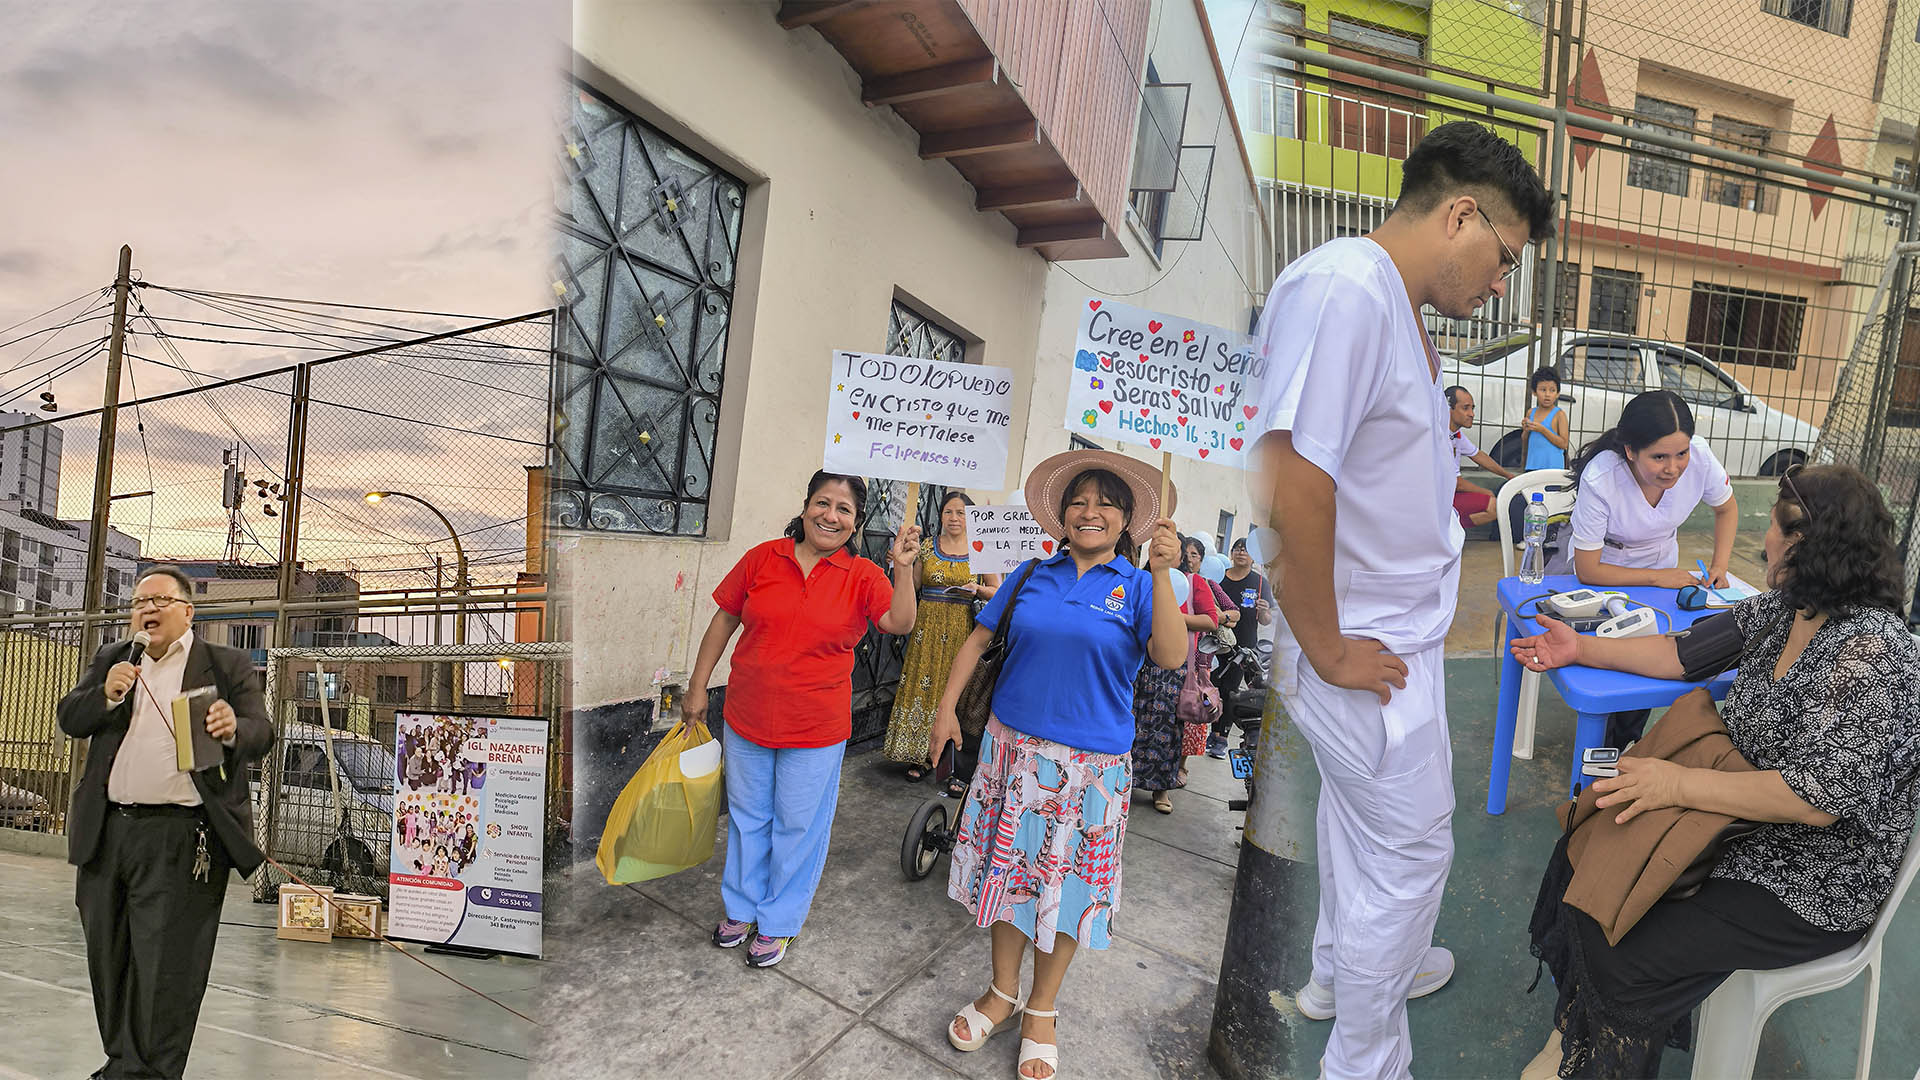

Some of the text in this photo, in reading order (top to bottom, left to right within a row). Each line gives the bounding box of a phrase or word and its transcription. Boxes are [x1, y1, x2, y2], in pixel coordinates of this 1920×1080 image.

[1088, 310, 1144, 351] Cree
[1150, 336, 1179, 357] en
[1186, 335, 1209, 363] el
[841, 353, 921, 384] TODO
[1097, 350, 1242, 408] Jesucristo y
[1113, 377, 1171, 410] Seras
[866, 415, 893, 432] me
[986, 408, 1010, 427] me
[1119, 410, 1179, 439] Hechos
[952, 456, 977, 470] 4:13
[971, 510, 995, 523] POR
[976, 526, 1010, 536] SALVADOS
[996, 537, 1036, 551] LA FÉ
[468, 741, 545, 755] IGL. NAZARETH
[517, 793, 538, 801] General
[494, 808, 519, 816] Medicinas
[506, 830, 533, 838] INFANTIL
[510, 823, 529, 831] SHOW
[493, 851, 513, 859] Servicio
[396, 876, 454, 887] ATENCIÓN COMUNIDAD
[498, 897, 509, 905] 955
[521, 900, 532, 908] 106
[467, 912, 493, 920] Dirección:
[500, 916, 540, 926] Castrovirreyna
[500, 922, 516, 930] Breña
